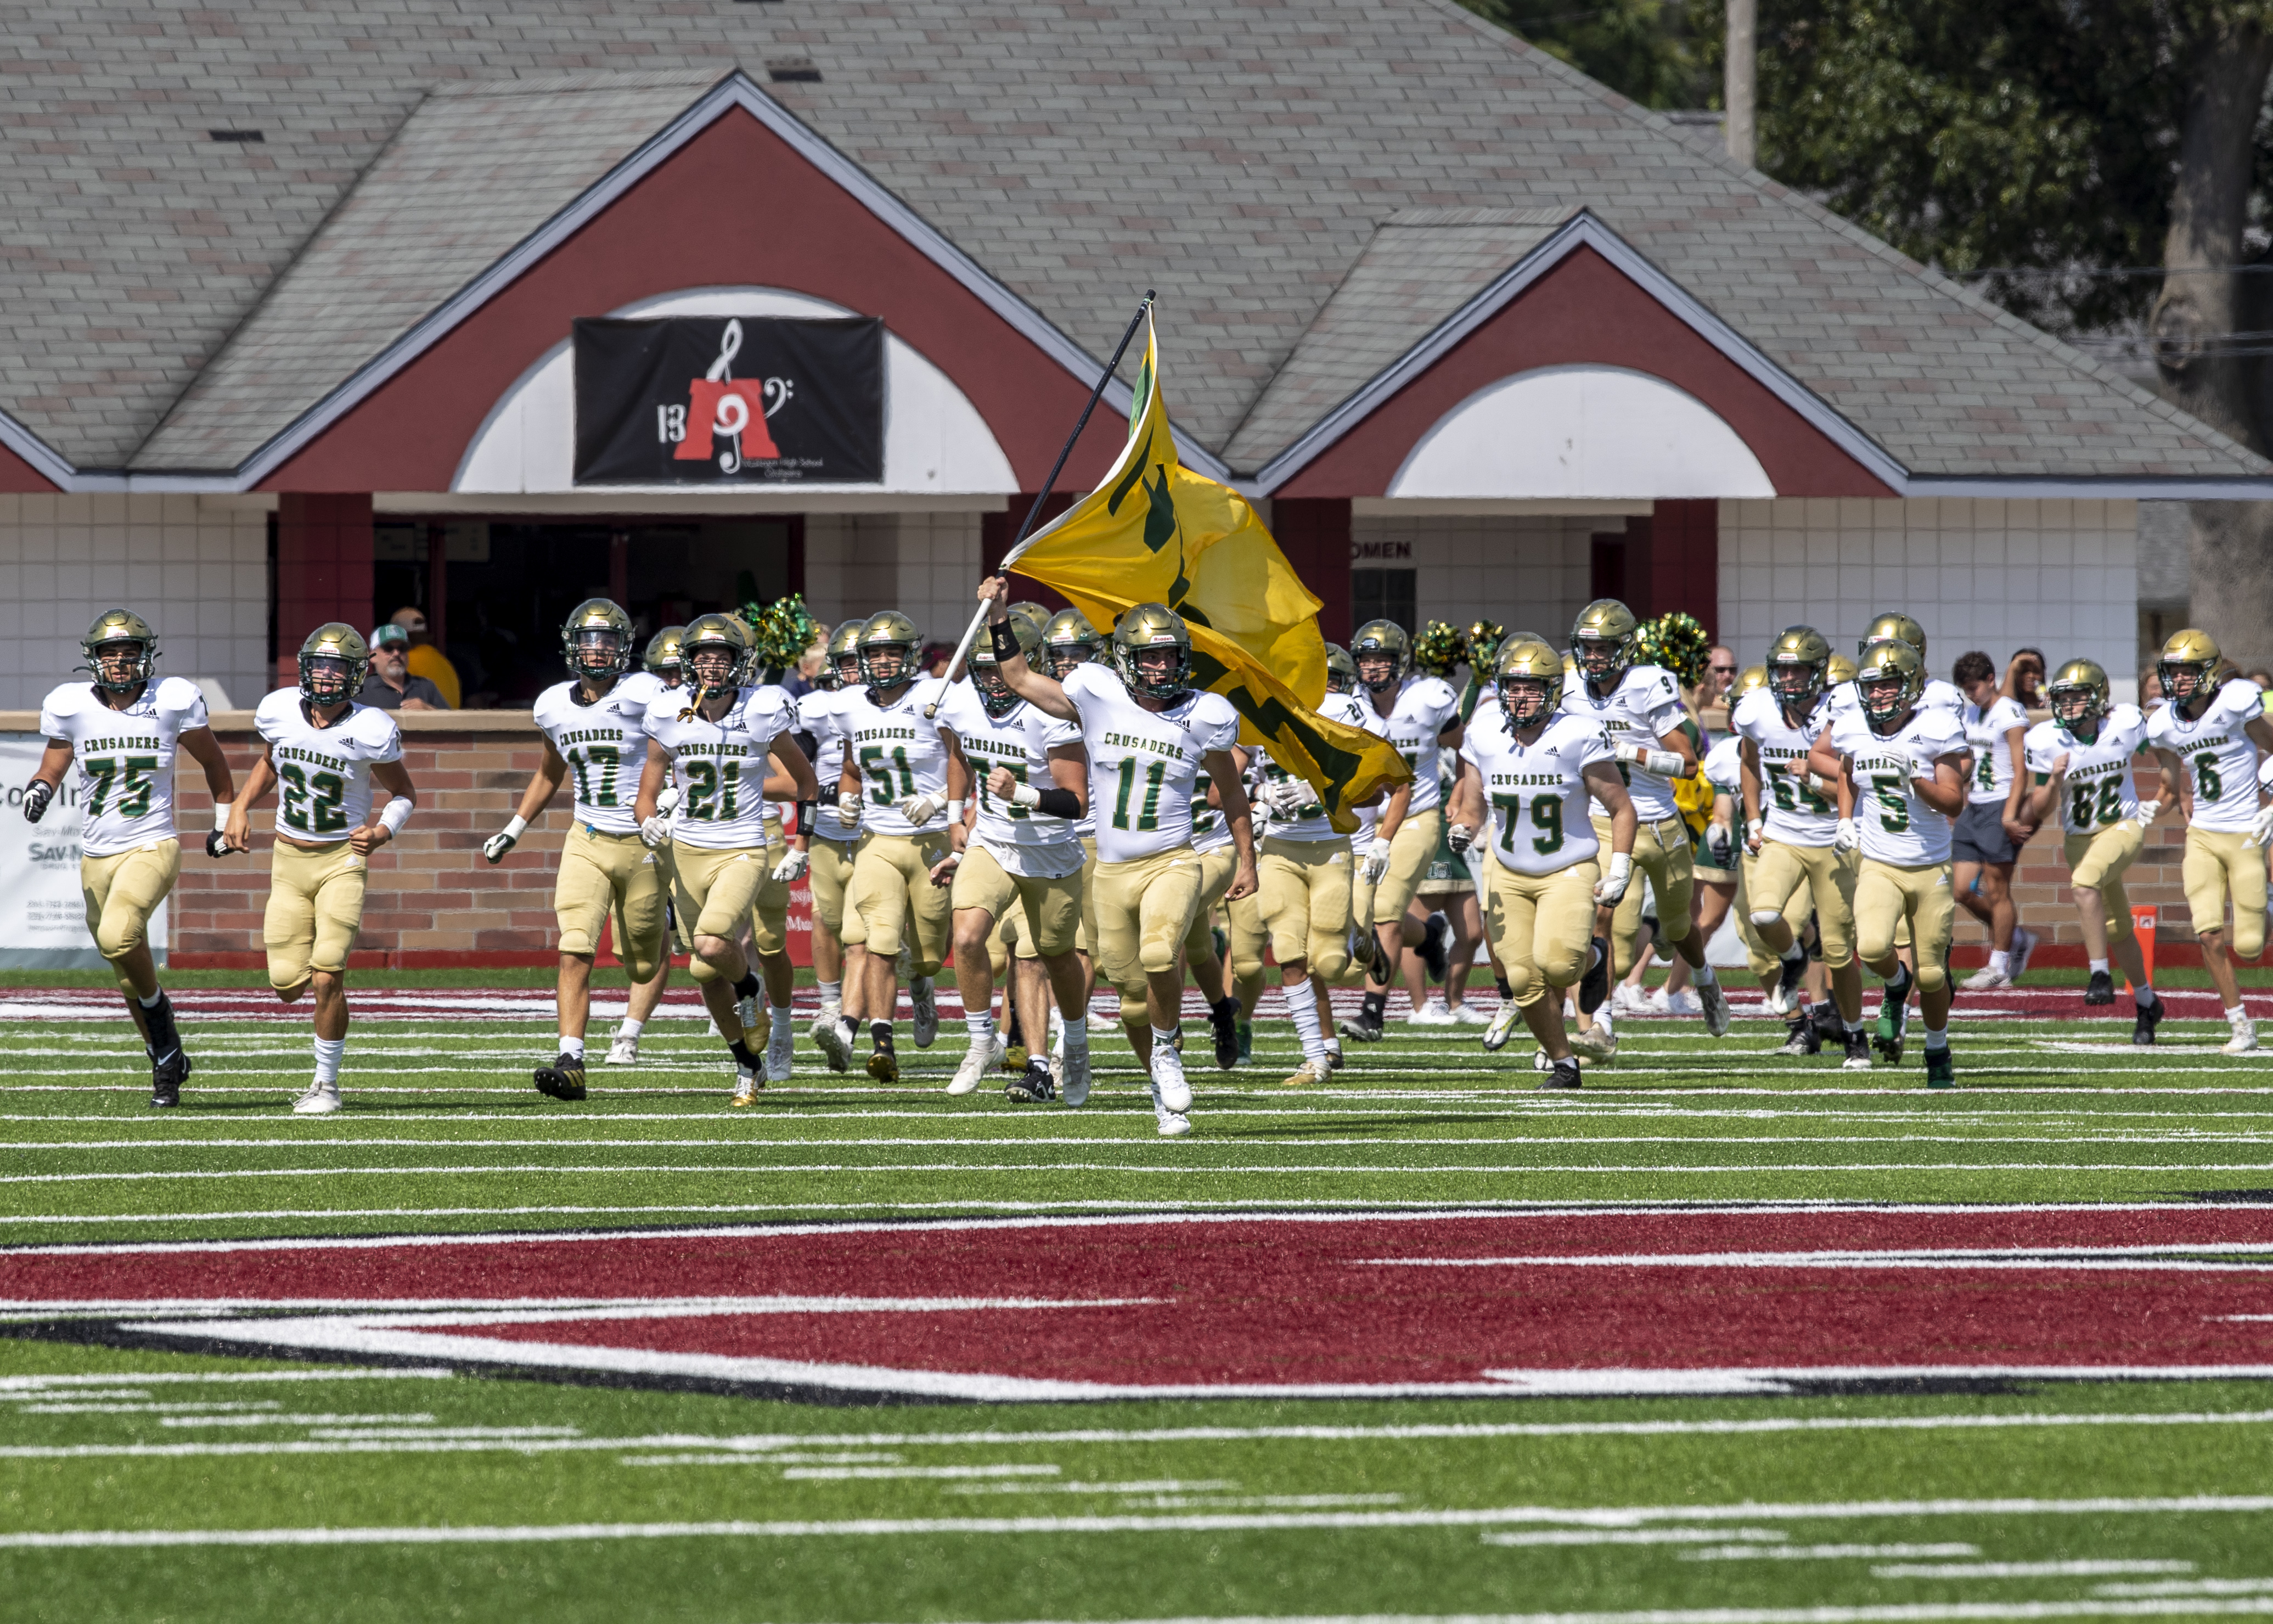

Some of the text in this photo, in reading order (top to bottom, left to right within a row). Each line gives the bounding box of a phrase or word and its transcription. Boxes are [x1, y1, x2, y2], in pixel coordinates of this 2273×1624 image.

[1350, 541, 1412, 559] OMEN
[1661, 676, 1673, 694] 9
[560, 729, 623, 747] CRUSADERS
[1174, 721, 1191, 733] adidas
[85, 737, 160, 752] CRUSADERS
[338, 739, 356, 750] adidas
[678, 743, 748, 757] CRUSADERS
[964, 737, 1026, 758] CRUSADERS
[1105, 732, 1184, 760] CRUSADERS
[279, 746, 346, 772] CRUSADERS
[2069, 758, 2127, 780] CRUSADERS
[85, 756, 157, 818] 75
[568, 746, 620, 807] 17
[860, 745, 919, 806] 51
[1491, 774, 1563, 785] CRUSADERS
[2193, 751, 2222, 803] 6
[281, 762, 347, 833] 22
[686, 760, 739, 821] 21
[1112, 755, 1167, 831] 11
[1871, 775, 1910, 833] 5
[2072, 773, 2124, 828] 66
[1491, 791, 1563, 857] 79
